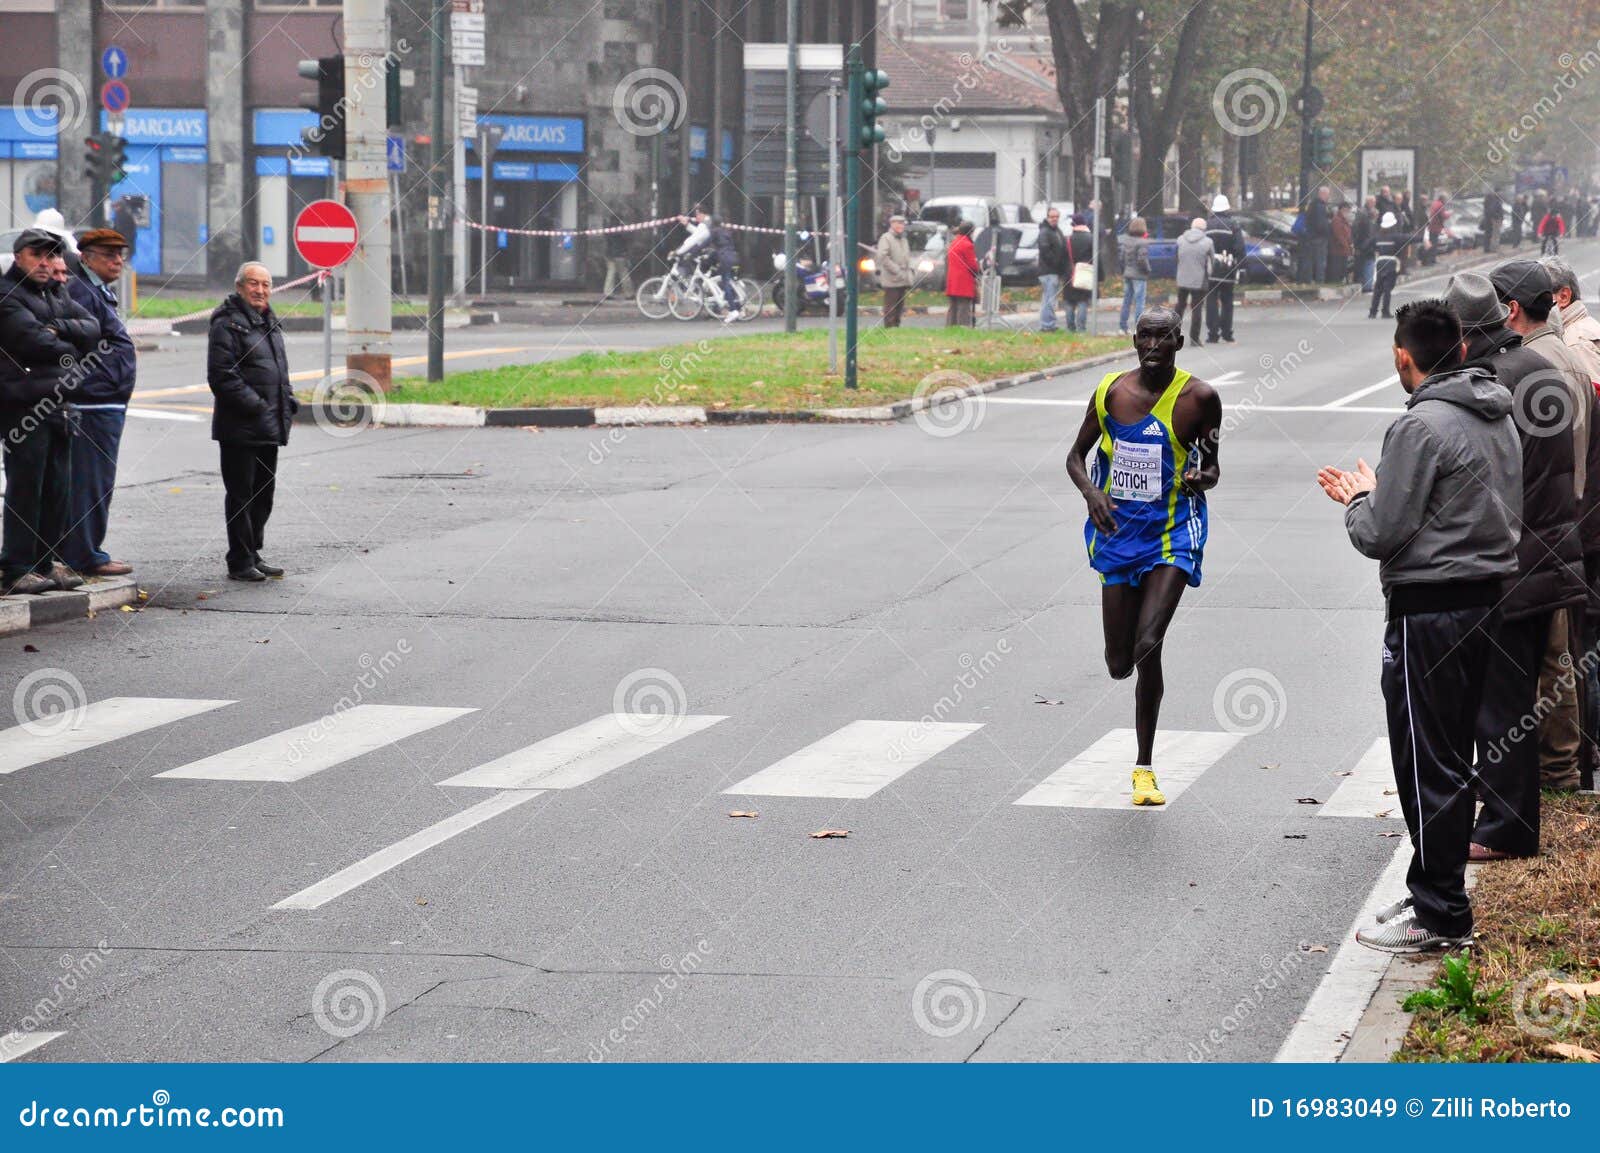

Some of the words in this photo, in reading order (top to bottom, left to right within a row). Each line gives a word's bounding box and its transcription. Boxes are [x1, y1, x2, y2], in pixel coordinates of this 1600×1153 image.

[127, 119, 203, 137] BARCLAYS
[502, 124, 566, 143] ARCLAYS
[1117, 456, 1157, 470] Kappa
[1112, 469, 1148, 490] ROTICH
